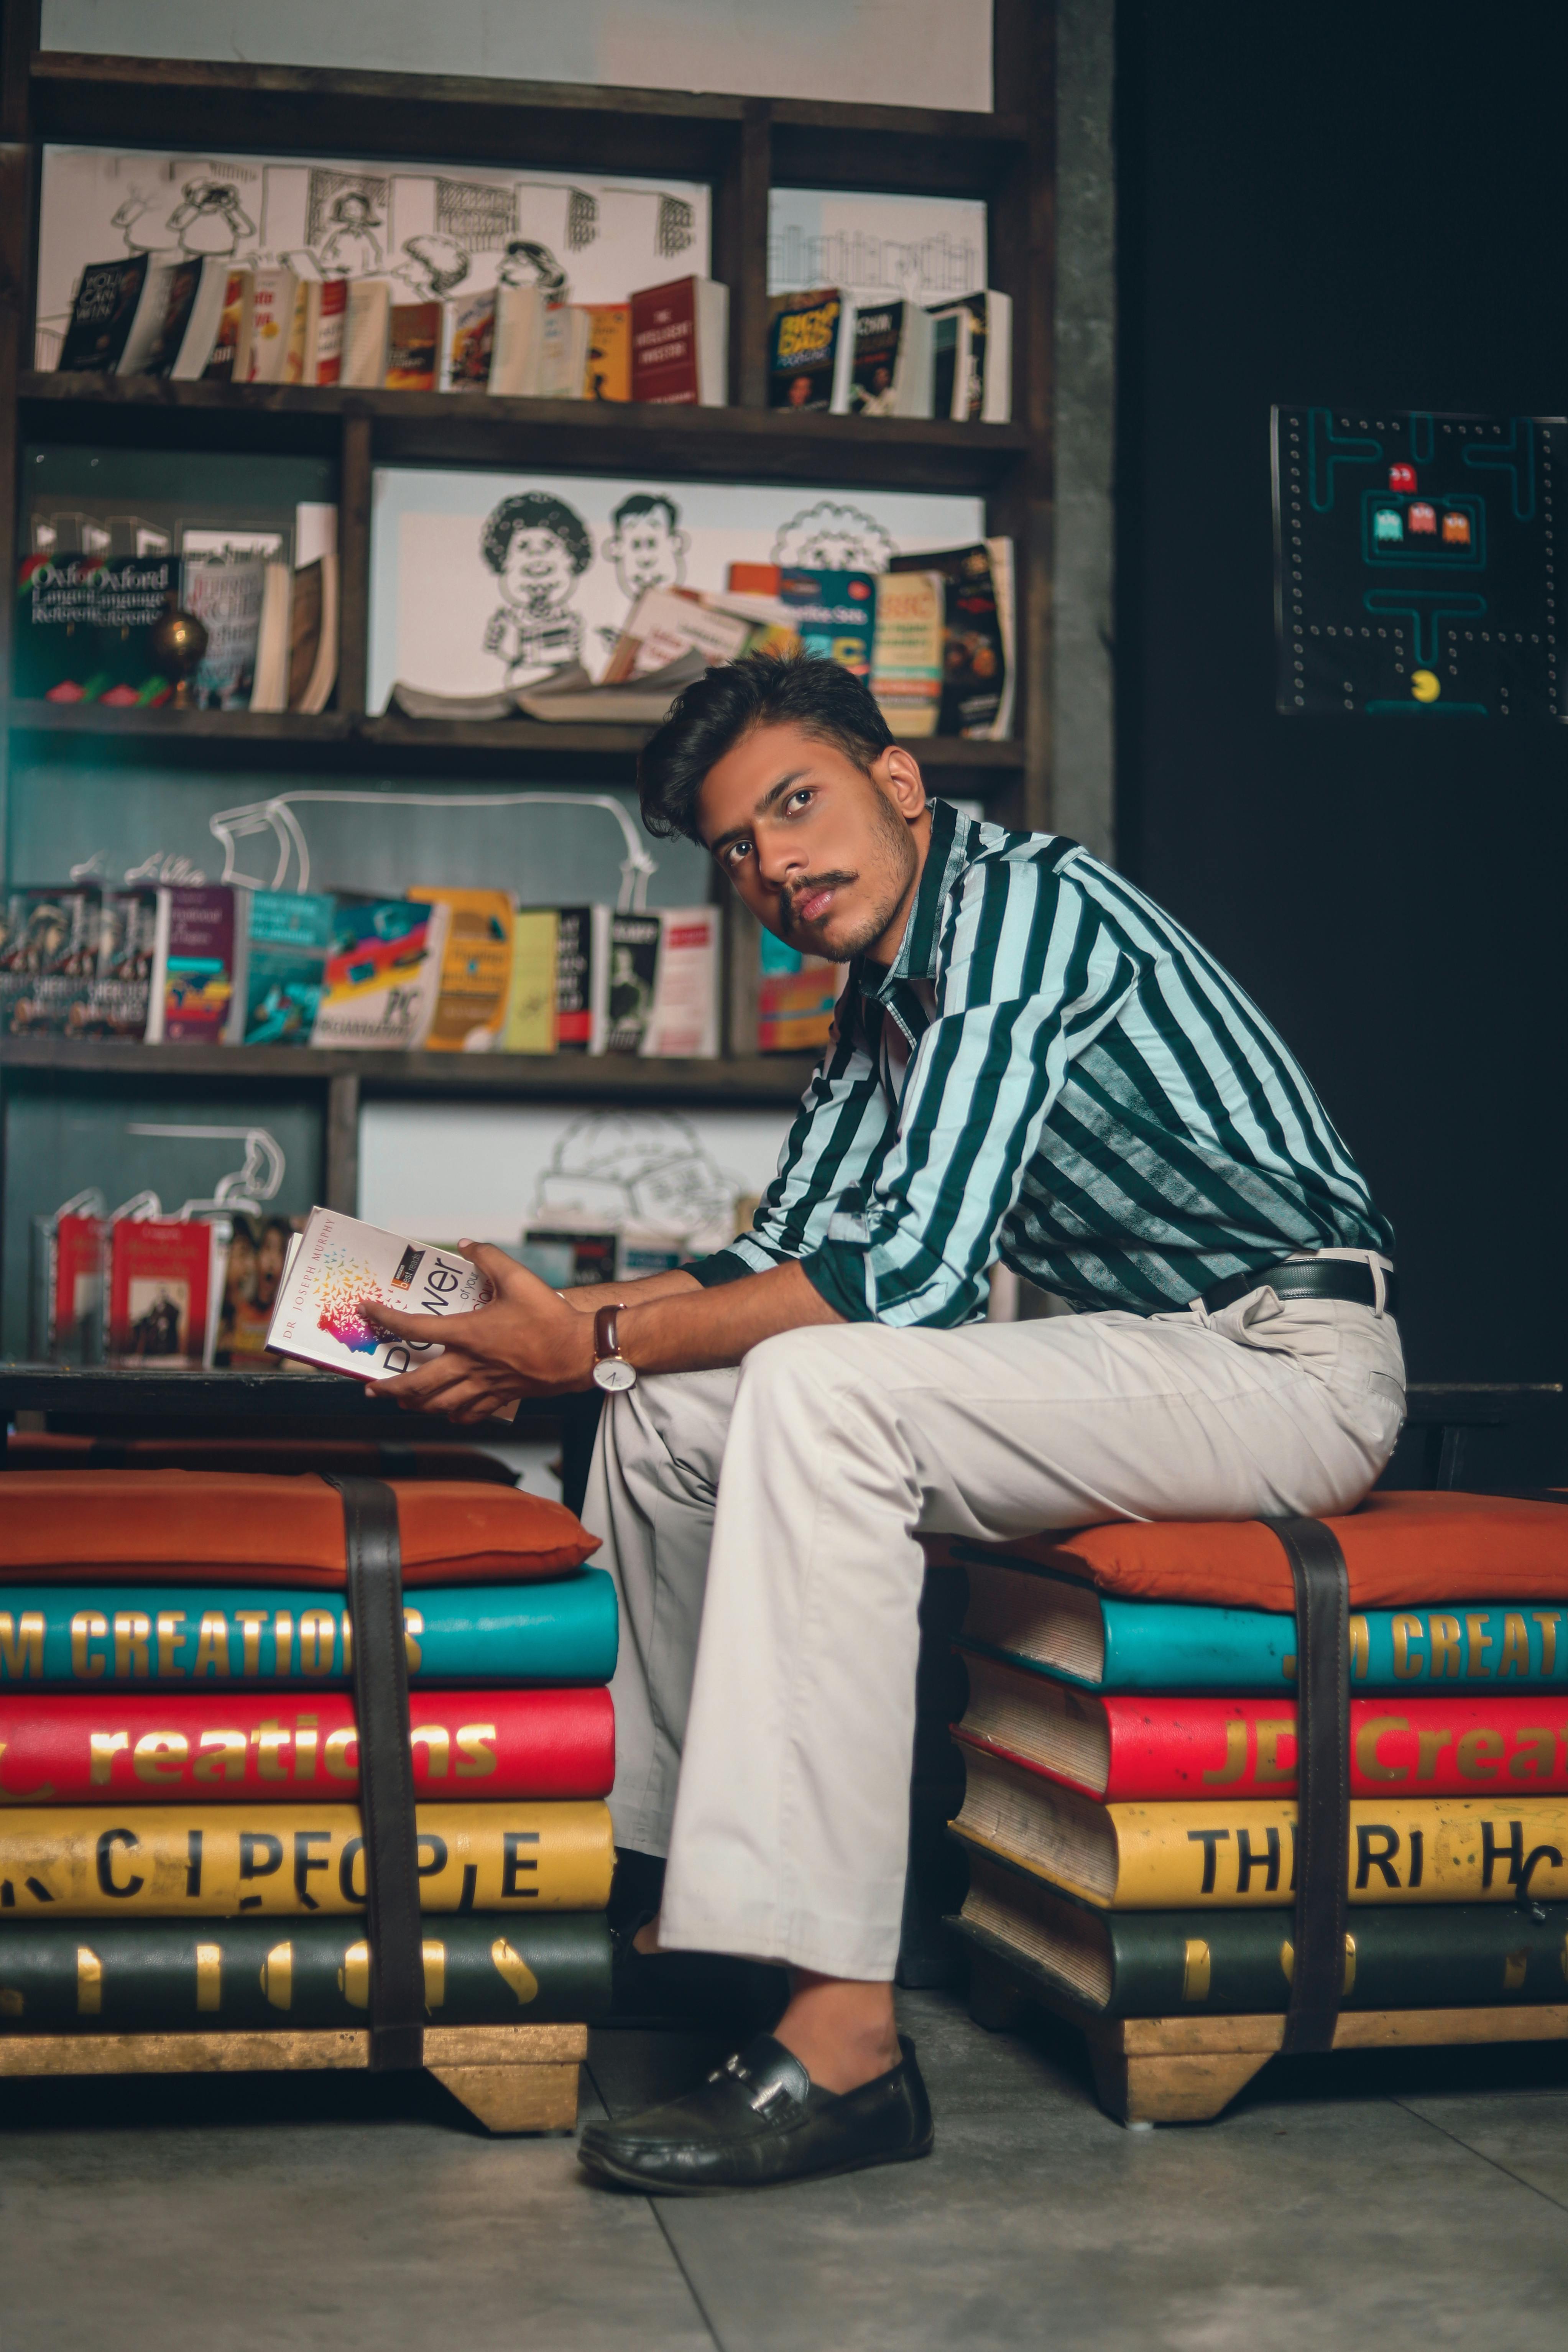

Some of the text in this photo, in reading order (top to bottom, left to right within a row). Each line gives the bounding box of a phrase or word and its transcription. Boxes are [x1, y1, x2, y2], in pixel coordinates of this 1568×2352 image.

[80, 289, 115, 306] CAN
[87, 563, 169, 591] Oxford
[283, 1219, 335, 1339] DR JOSEPH MURPHY
[390, 1253, 421, 1289] best reads
[395, 1265, 405, 1280] amazon
[460, 1272, 479, 1300] of your
[1356, 1717, 1568, 1782] Crea
[1187, 1827, 1299, 1894] TH
